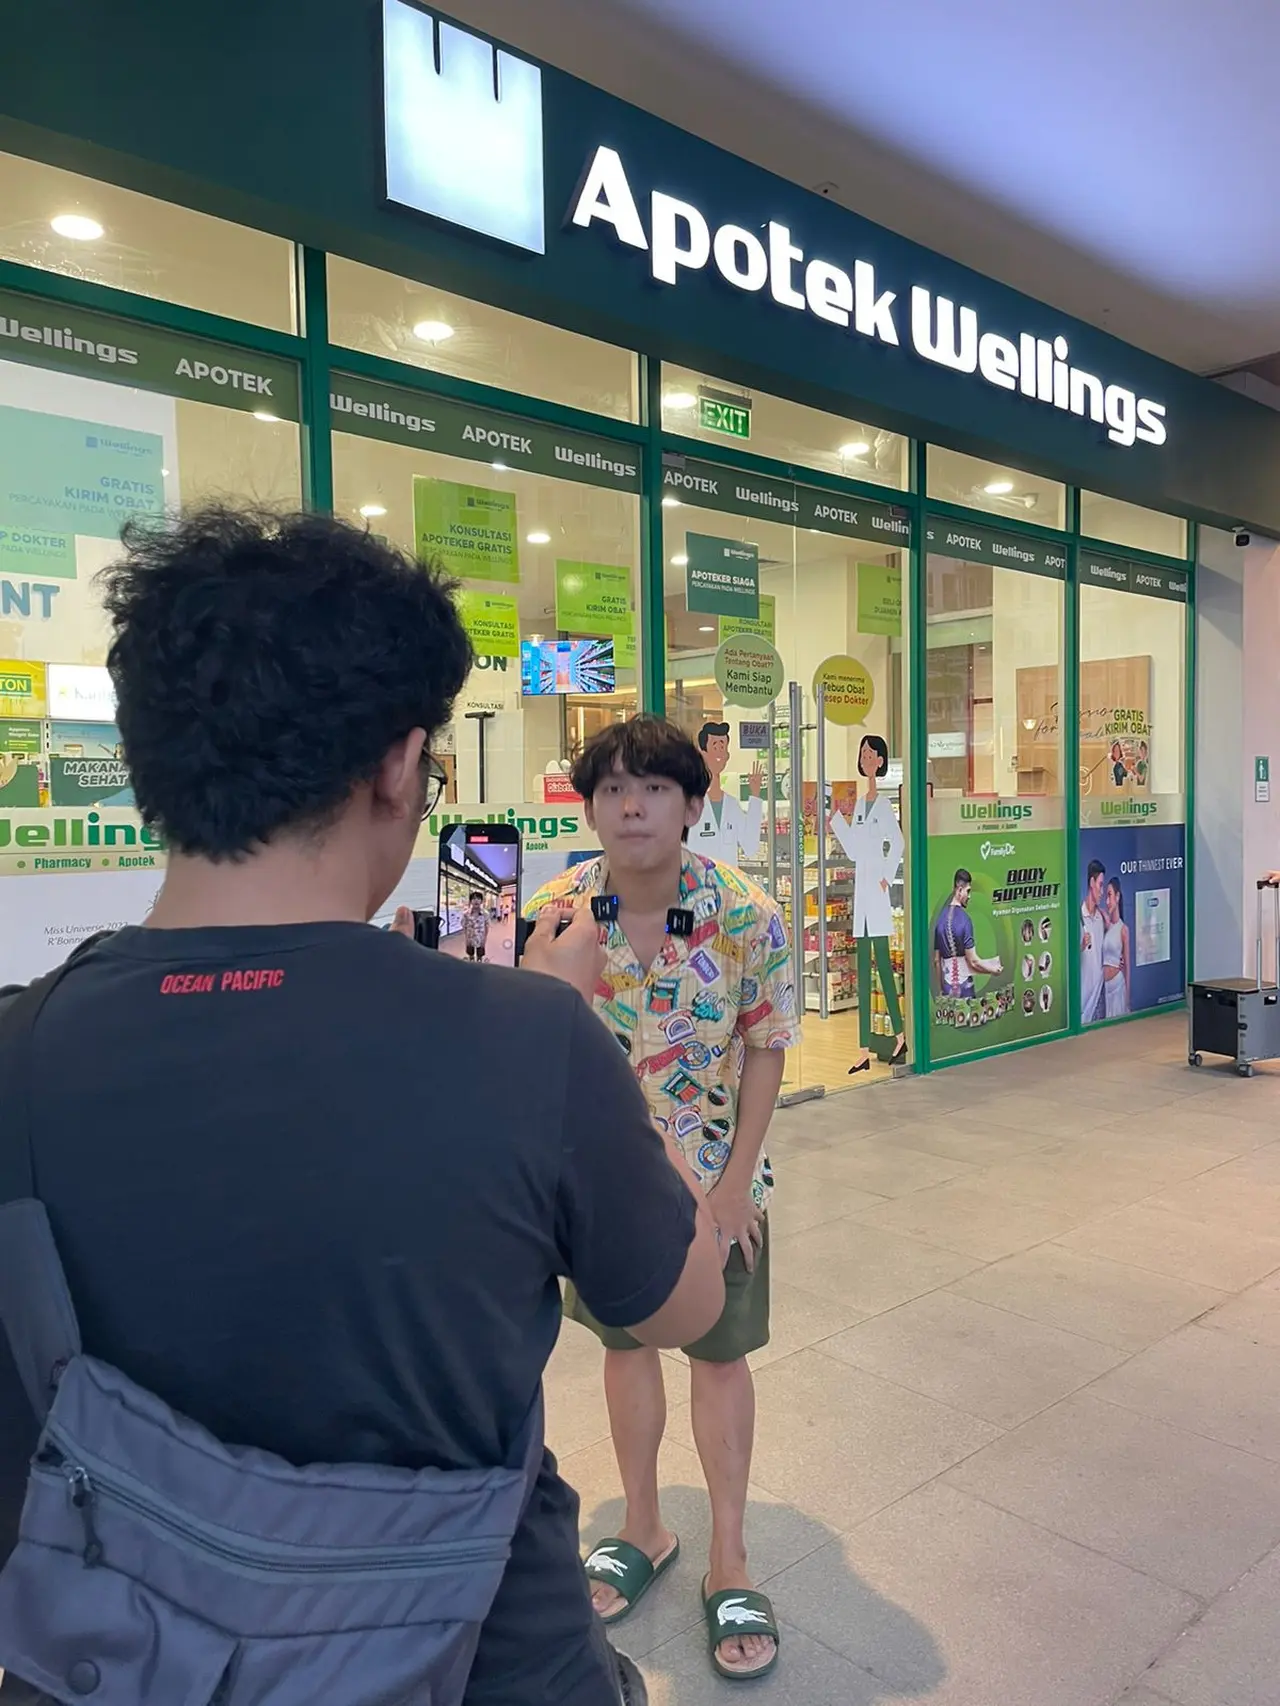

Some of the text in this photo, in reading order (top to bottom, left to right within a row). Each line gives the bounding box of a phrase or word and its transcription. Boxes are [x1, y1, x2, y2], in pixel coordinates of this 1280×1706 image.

[572, 145, 1167, 447] Apotek Wellings
[175, 358, 273, 396] APOTEK
[703, 402, 747, 434] EXIT
[330, 393, 636, 477] Wellings APOTEK Wellings
[101, 476, 155, 495] GRATIS
[65, 486, 155, 510] KIRIM OBAT
[664, 471, 718, 495] APOTEK
[736, 487, 799, 513] Wellings
[814, 504, 858, 525] APOTEK
[12, 532, 66, 549] DOKTER
[449, 524, 512, 542] KONSULTASI
[422, 533, 475, 550] APOTEKER
[477, 541, 513, 555] GRATIS
[946, 532, 982, 551] APOTEK
[992, 543, 1035, 563] Wellings
[691, 570, 755, 587] APOTEKER SIAGA
[1090, 564, 1127, 582] Wellings
[1136, 574, 1161, 588] APOTEK
[602, 596, 627, 605] GRATIS
[724, 657, 750, 667] Tentang
[727, 669, 772, 685] Kami Siap
[725, 681, 773, 696] Membantu
[823, 682, 865, 695] Tebus Obat
[467, 701, 504, 710] KONSULTASI
[824, 694, 869, 706] esep Dokter
[1113, 708, 1144, 722] GRATIS
[743, 724, 767, 735] BUKA
[1105, 722, 1128, 735] KIRIM
[1130, 723, 1154, 737] OBAT
[63, 761, 128, 775] MAKANA
[78, 773, 128, 787] SEHAT
[961, 800, 1033, 820] Wellings
[1101, 798, 1157, 816] Wellings
[34, 855, 156, 869] Pharmacy Apotek
[1120, 860, 1137, 874] OUR
[1166, 857, 1184, 870] EVER
[1006, 867, 1047, 885] BODY
[992, 883, 1061, 905] SUPPORT
[44, 926, 64, 935] Miss
[65, 923, 104, 934] Universe
[160, 969, 284, 994] OCEAN PACIFIC
